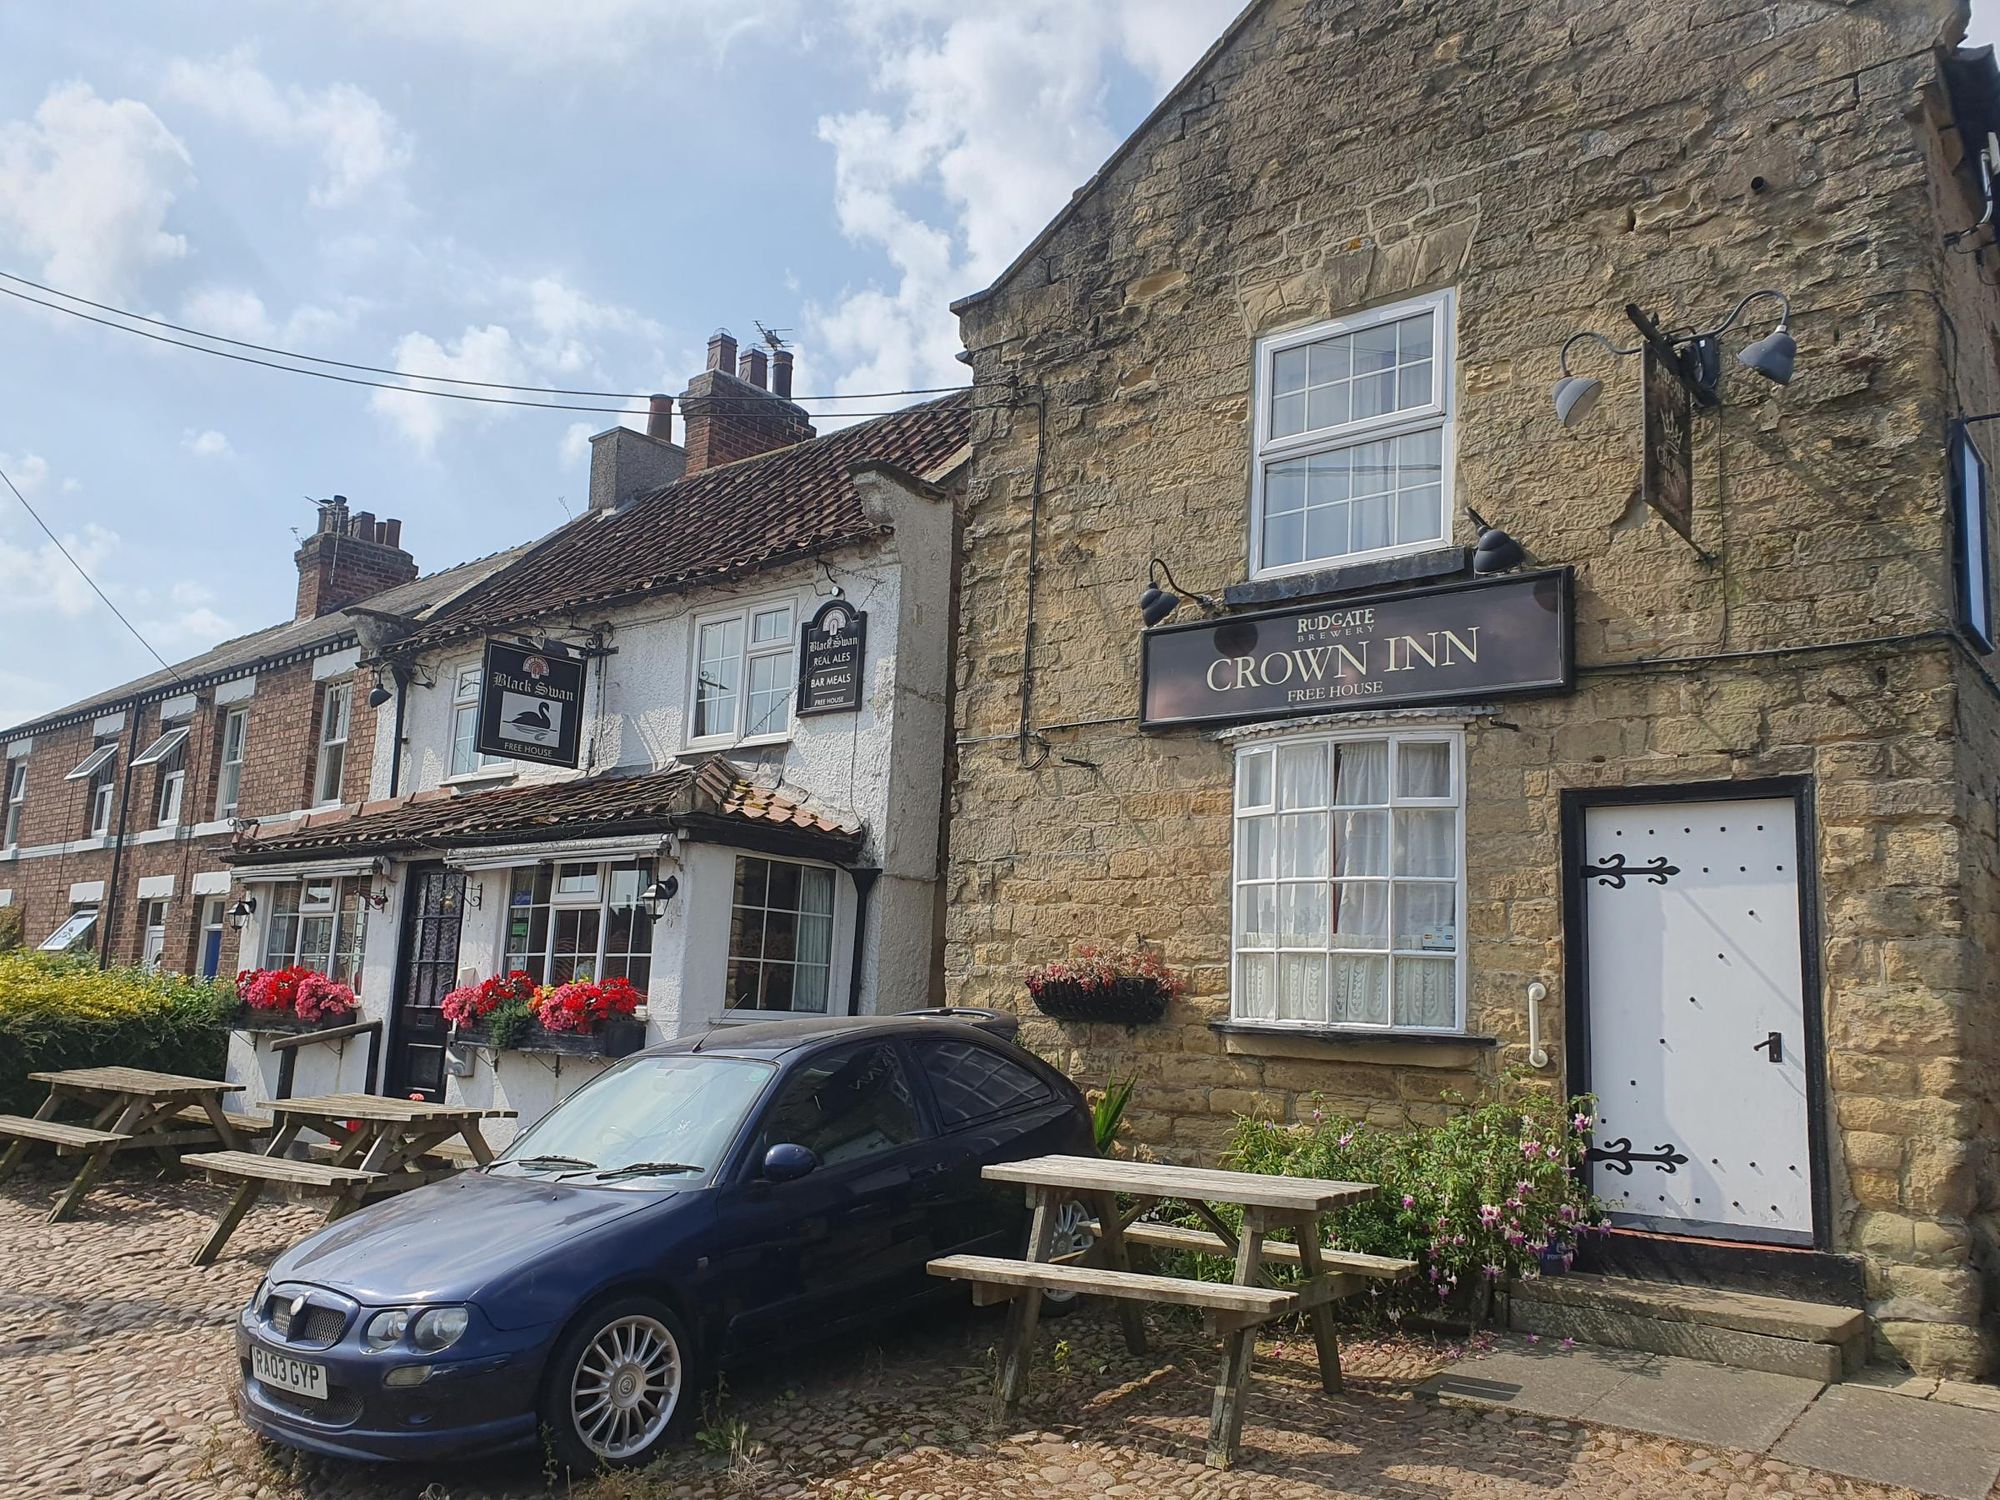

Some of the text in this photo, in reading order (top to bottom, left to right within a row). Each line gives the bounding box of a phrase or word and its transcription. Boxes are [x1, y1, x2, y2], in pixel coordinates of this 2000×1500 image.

[1297, 608, 1375, 634] RUDGATE
[1297, 625, 1375, 643] BREWERY
[809, 637, 832, 652] Black
[813, 652, 851, 666] REAL ALES
[1206, 626, 1480, 691] CROWN INN
[493, 671, 573, 701] Black Swan
[810, 673, 851, 688] BAR MEALS
[1287, 681, 1384, 702] FREE HOUSE
[814, 696, 844, 706] FREE HOUSE
[504, 741, 553, 757] FREE HOUSE
[256, 1349, 319, 1390] RA03 GYP
